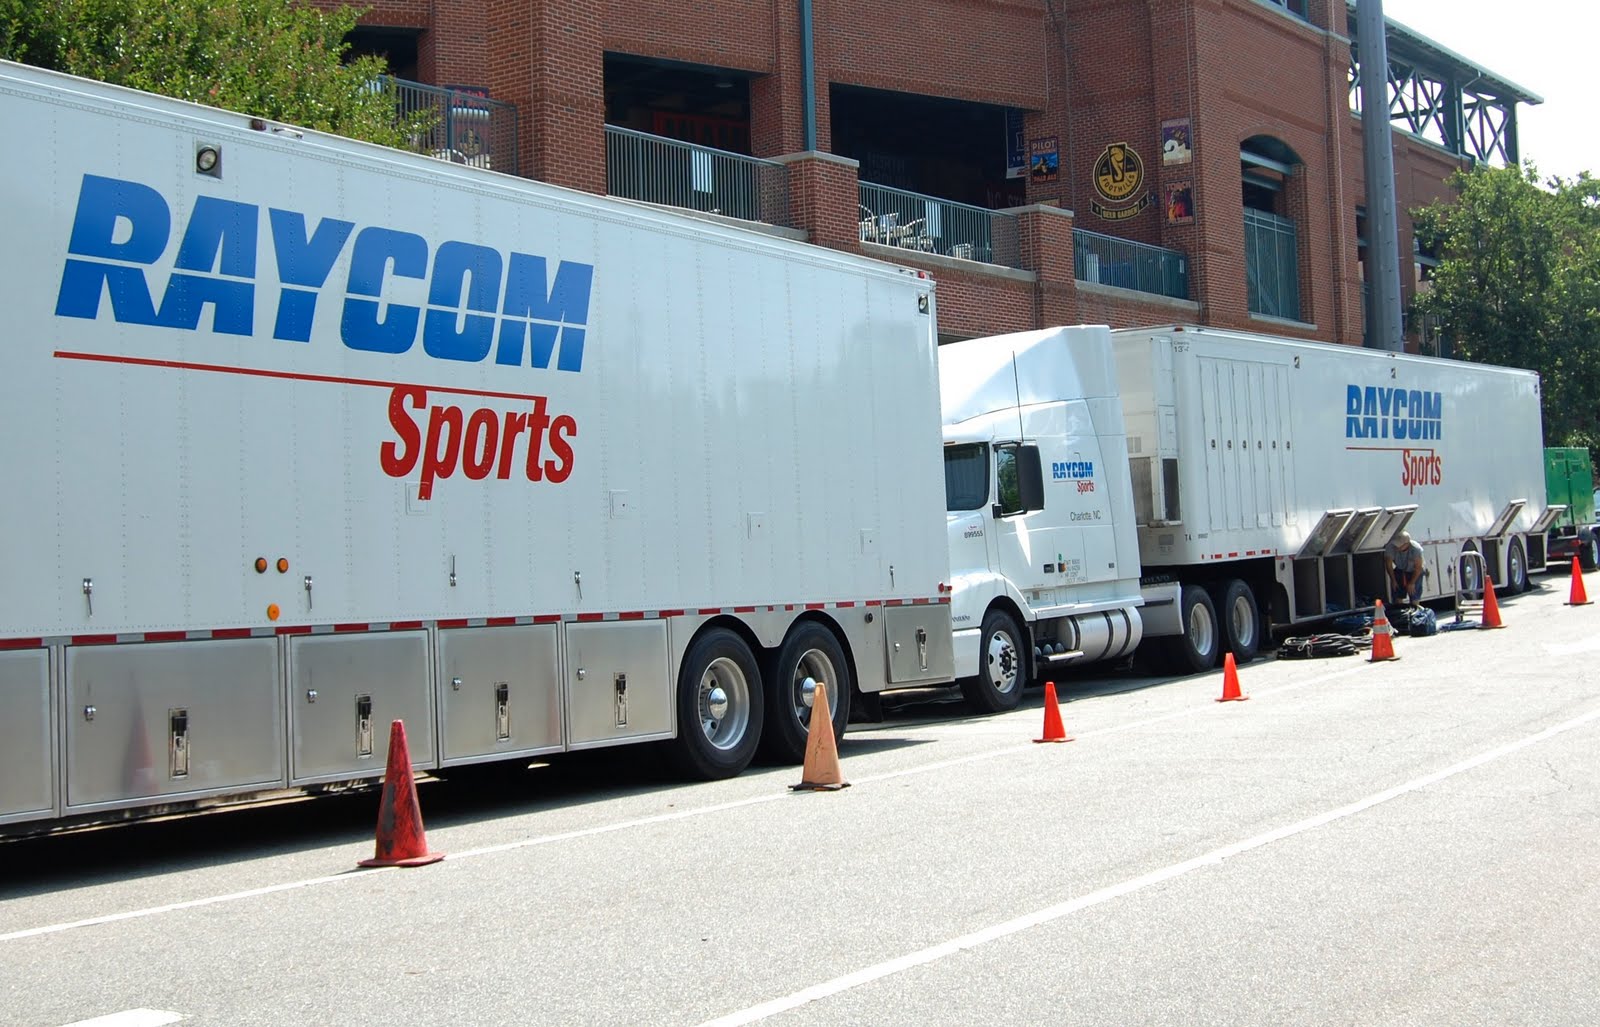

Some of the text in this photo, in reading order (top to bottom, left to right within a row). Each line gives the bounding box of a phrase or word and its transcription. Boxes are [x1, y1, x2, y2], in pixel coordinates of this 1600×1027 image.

[1032, 141, 1056, 151] PILOT
[1102, 174, 1135, 193] FOOTHILLS
[55, 173, 594, 373] RAYCOM
[1346, 384, 1442, 440] RAYCOM
[380, 384, 578, 500] Sports
[1052, 461, 1094, 479] RAYCOM
[1402, 448, 1442, 495] Sports
[1077, 480, 1095, 496] Sports
[1093, 510, 1101, 520] NC
